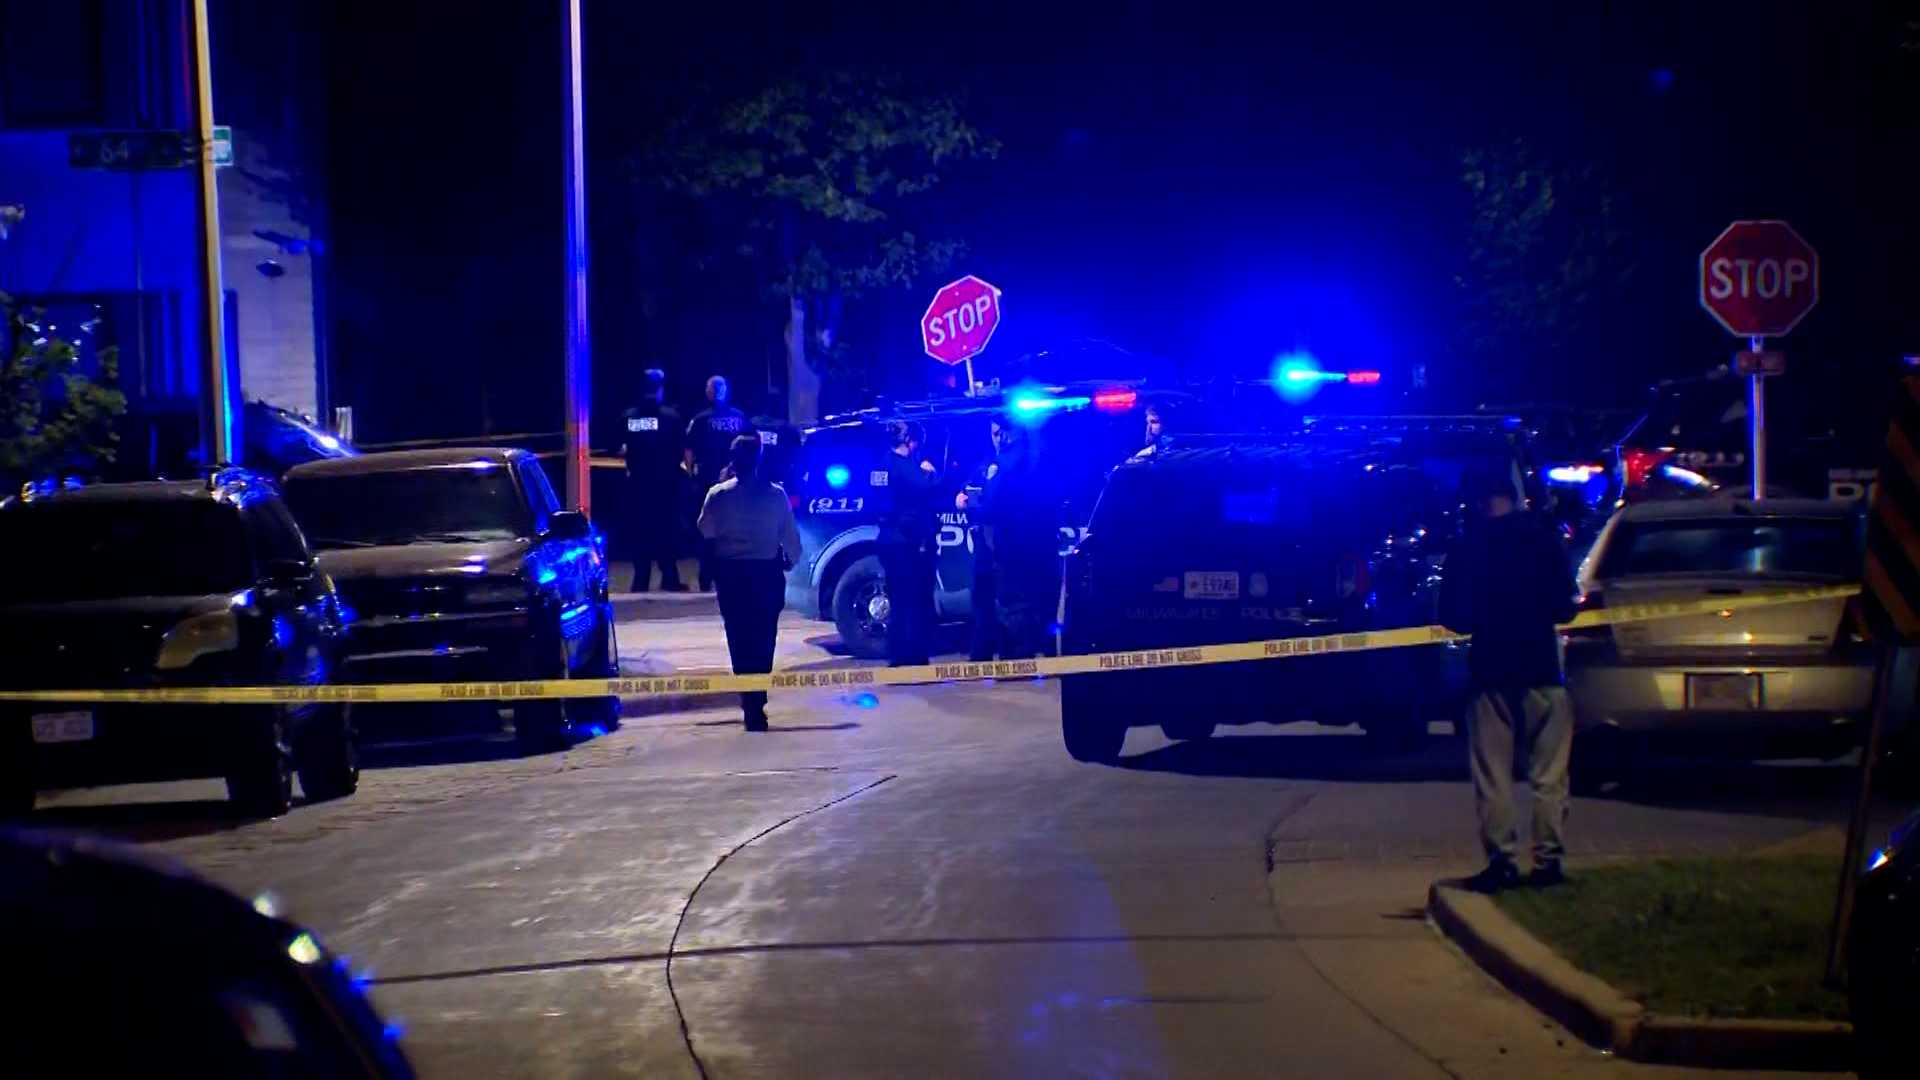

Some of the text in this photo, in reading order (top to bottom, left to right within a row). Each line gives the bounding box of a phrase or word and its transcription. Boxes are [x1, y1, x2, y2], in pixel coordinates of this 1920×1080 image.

[1709, 256, 1810, 300] STOP
[928, 294, 992, 346] STOP
[816, 497, 864, 513] 911
[1100, 655, 1126, 669] POLICE
[936, 663, 961, 679] POLICE
[608, 680, 633, 694] POLICE
[772, 674, 798, 688] POLICE
